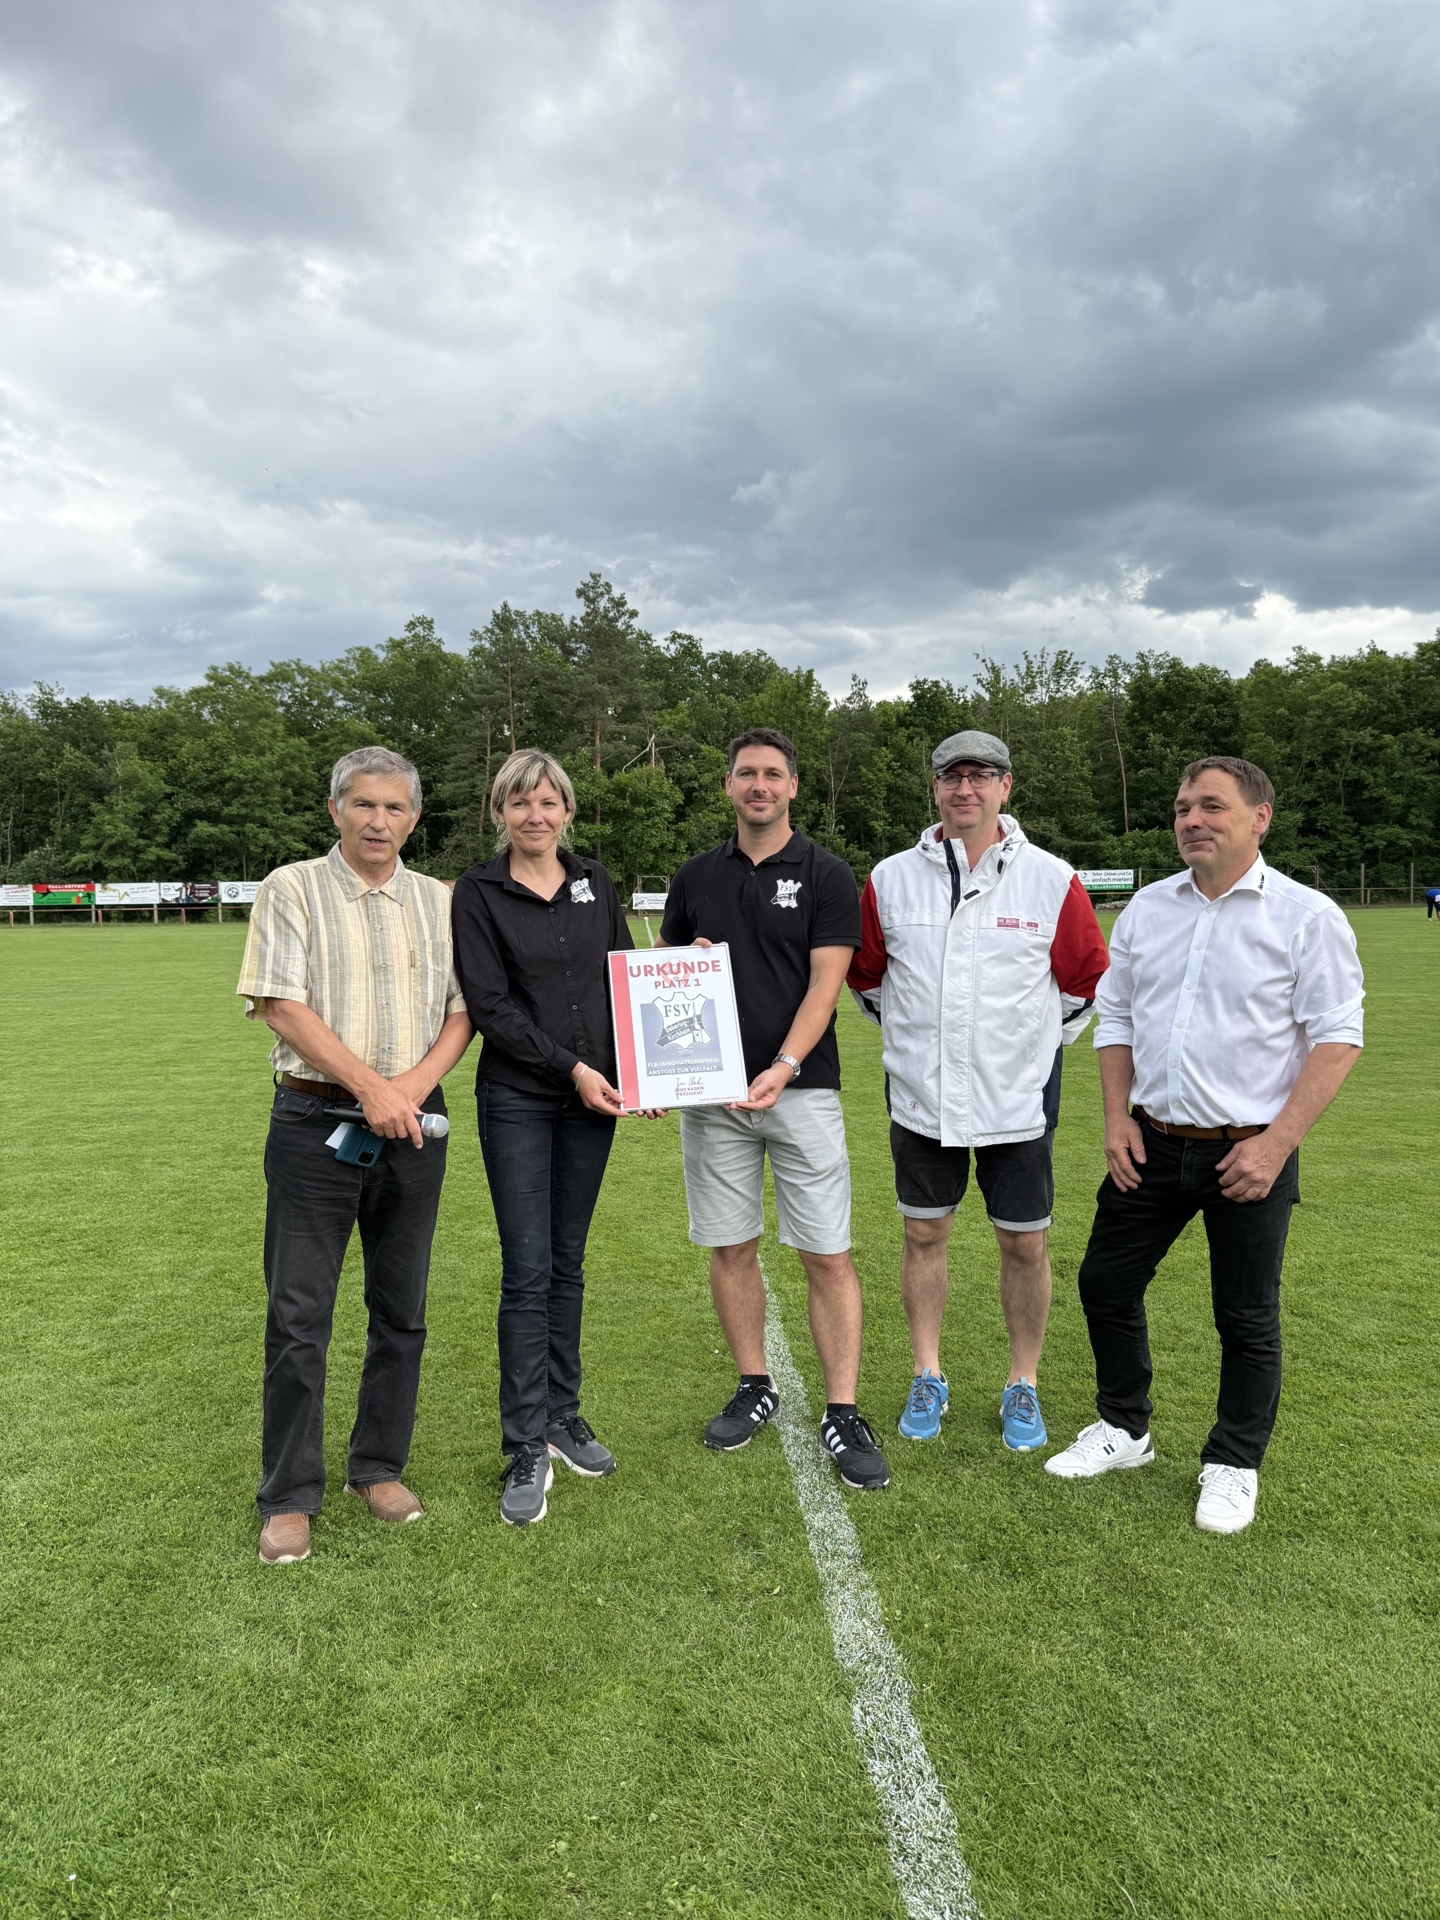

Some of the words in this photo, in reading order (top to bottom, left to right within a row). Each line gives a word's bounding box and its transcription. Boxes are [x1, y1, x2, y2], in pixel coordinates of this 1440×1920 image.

[780, 884, 794, 892] FSV
[629, 960, 721, 978] URKUNDE
[654, 979, 690, 989] PLATZ
[694, 978, 701, 987] 1
[663, 1003, 691, 1017] FSV
[647, 1057, 720, 1068] FLB-INNOVATIONSPREIS:
[648, 1067, 676, 1075] ANSTOSS
